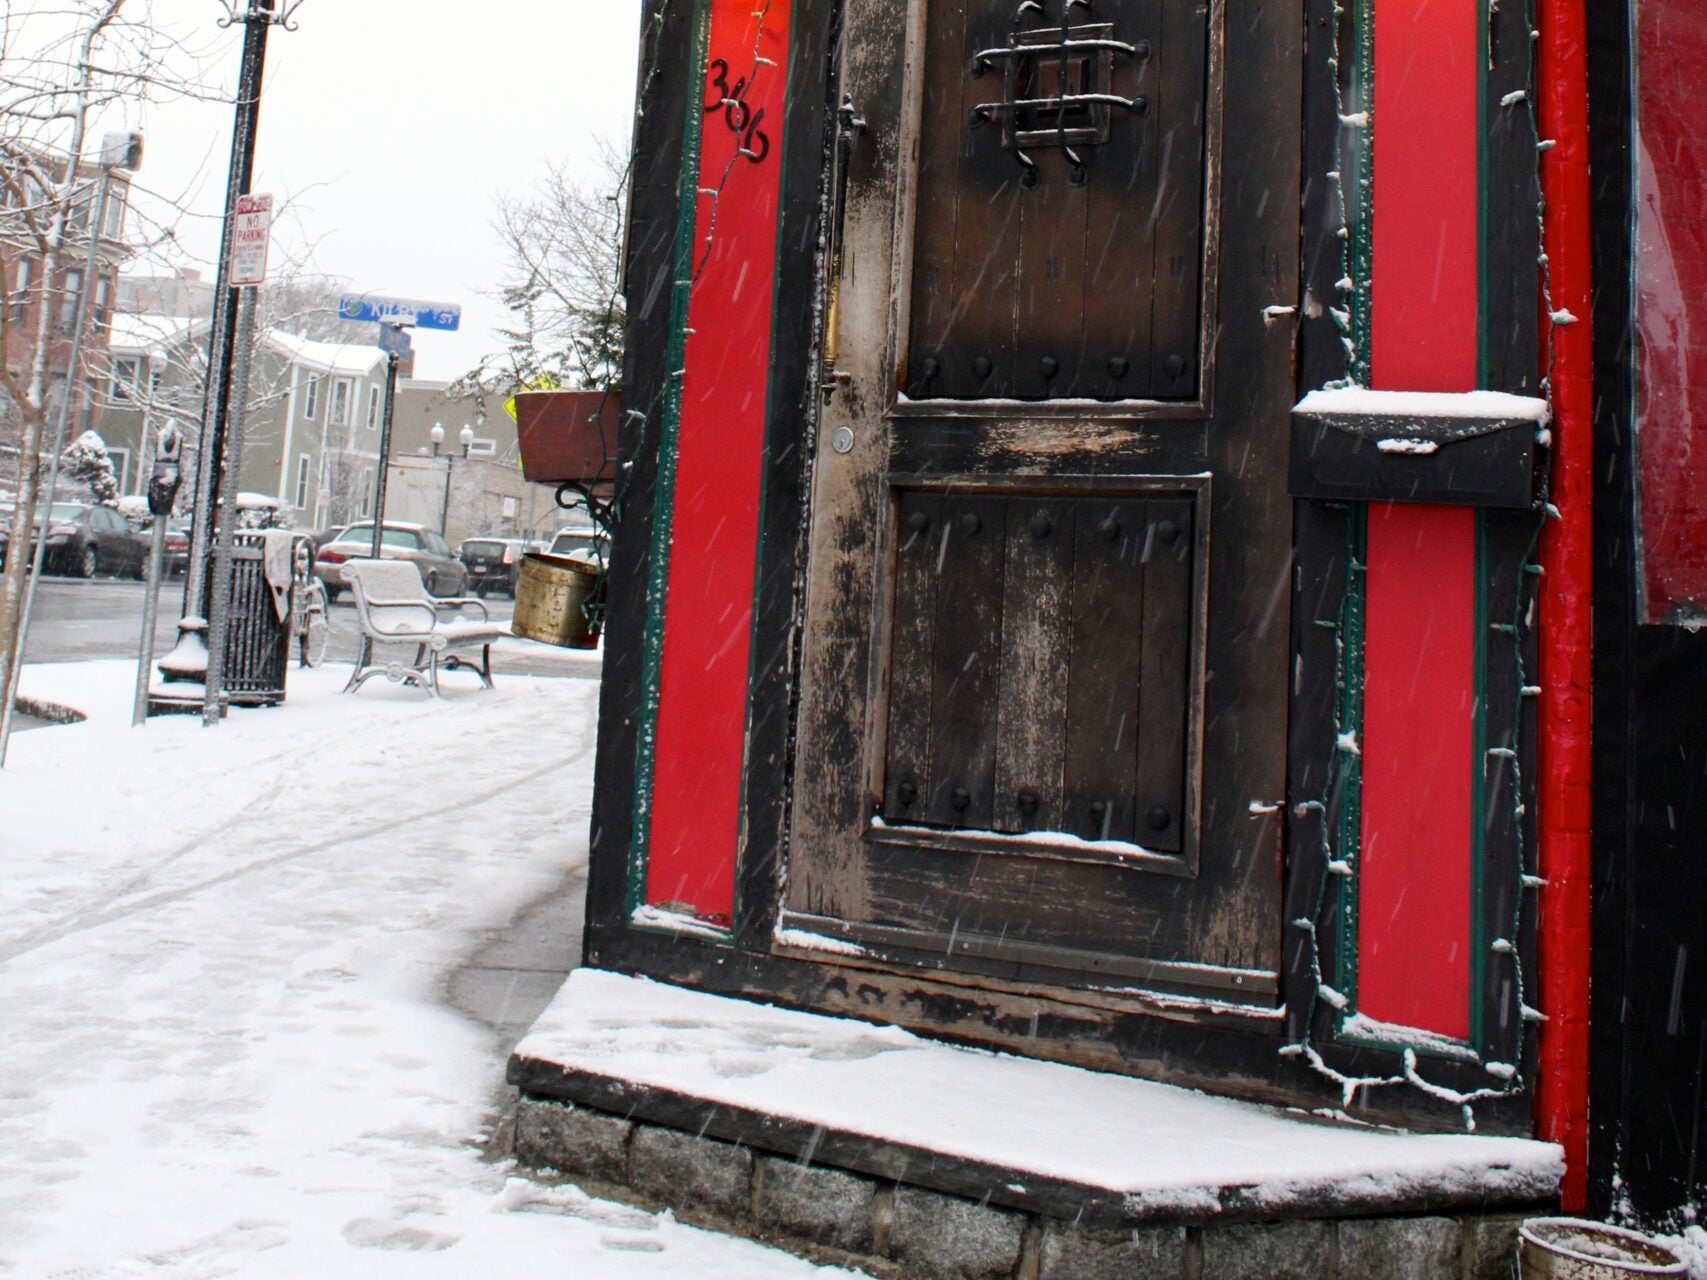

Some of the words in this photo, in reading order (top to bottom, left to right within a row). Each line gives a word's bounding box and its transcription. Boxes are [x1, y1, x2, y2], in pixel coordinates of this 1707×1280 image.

[703, 58, 769, 163] 366
[246, 215, 259, 228] NO
[237, 228, 266, 242] PARKING
[438, 312, 454, 325] ST
